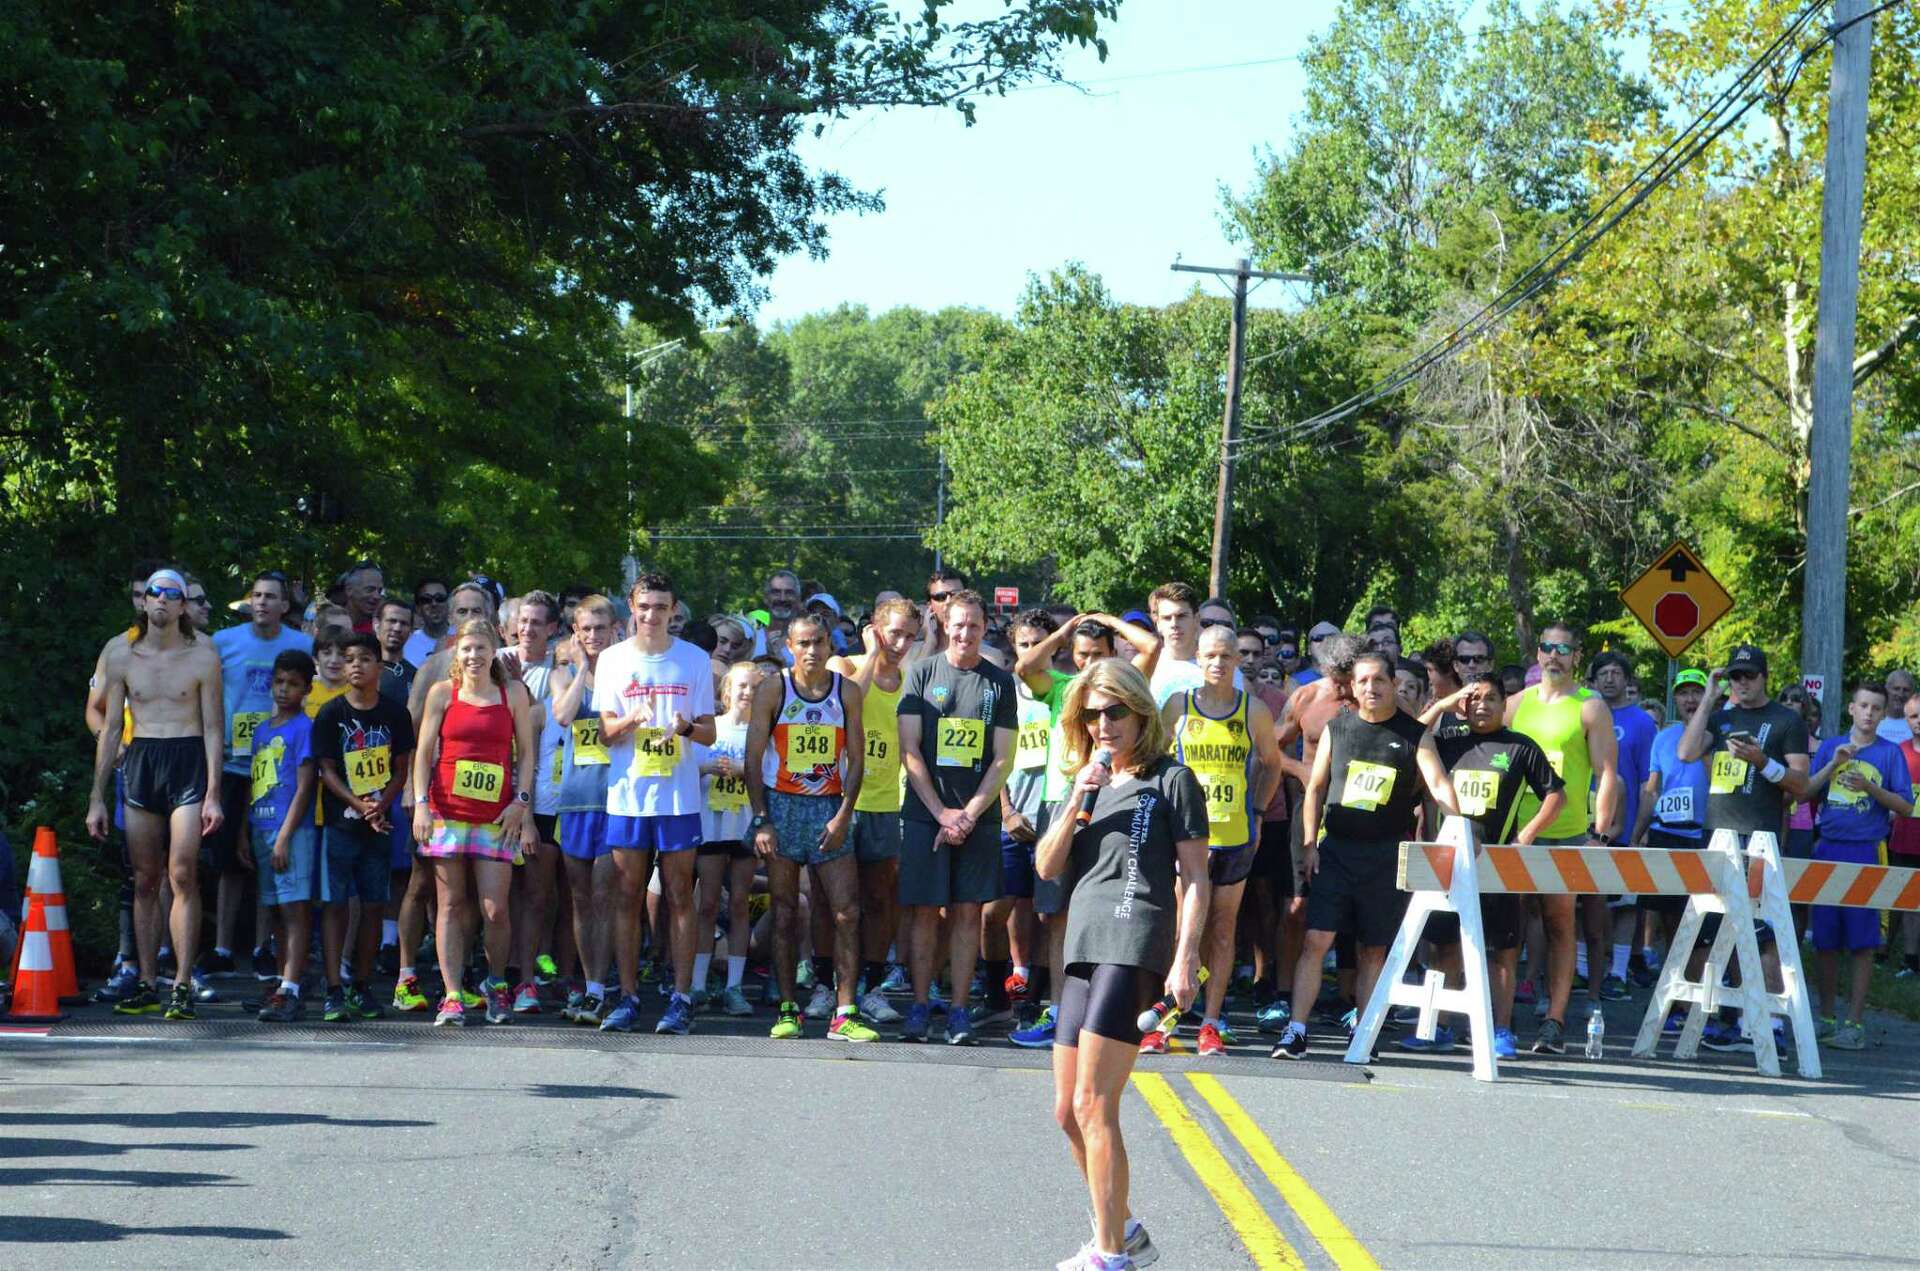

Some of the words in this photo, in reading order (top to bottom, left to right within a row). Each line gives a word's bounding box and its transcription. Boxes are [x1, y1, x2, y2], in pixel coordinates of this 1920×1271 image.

[1805, 680, 1822, 690] NO
[642, 738, 675, 756] 446
[795, 736, 829, 754] 348
[944, 729, 978, 748] 222
[1020, 729, 1048, 750] 418
[867, 740, 887, 759] 19
[355, 757, 385, 779] 416
[1716, 761, 1741, 777] 193
[462, 770, 496, 792] 308
[715, 776, 746, 795] 483
[1354, 773, 1387, 793] 407
[1460, 781, 1491, 799] 405
[1660, 795, 1690, 813] 1209
[1128, 794, 1150, 857] COMMUNITY
[1120, 857, 1138, 920] CHALLENGE
